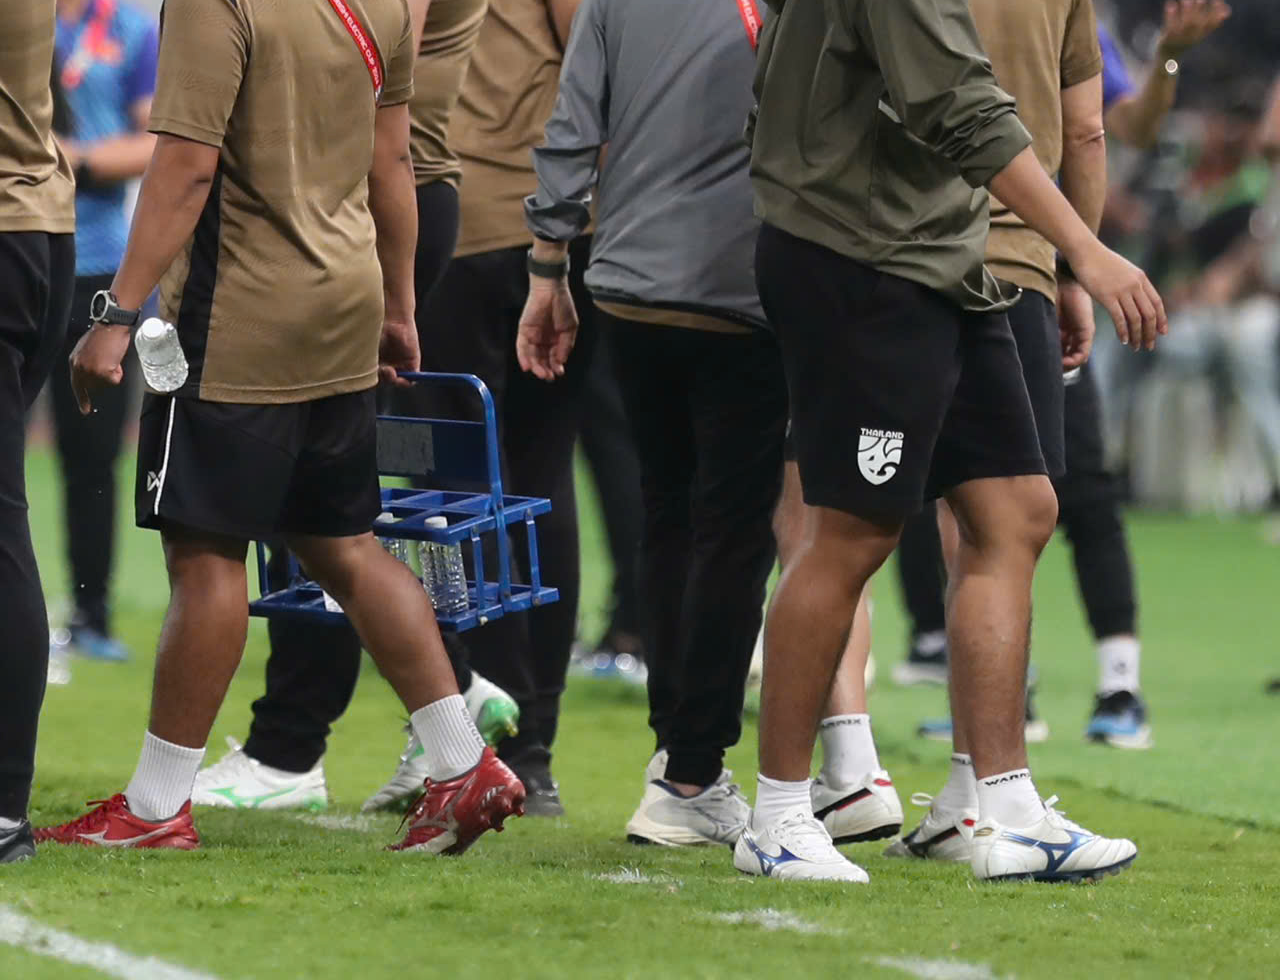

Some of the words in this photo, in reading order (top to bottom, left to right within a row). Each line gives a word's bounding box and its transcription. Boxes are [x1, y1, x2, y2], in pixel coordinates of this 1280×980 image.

[346, 16, 368, 51] ELECTRIC
[365, 49, 375, 67] CUP
[860, 427, 904, 440] THAILAND
